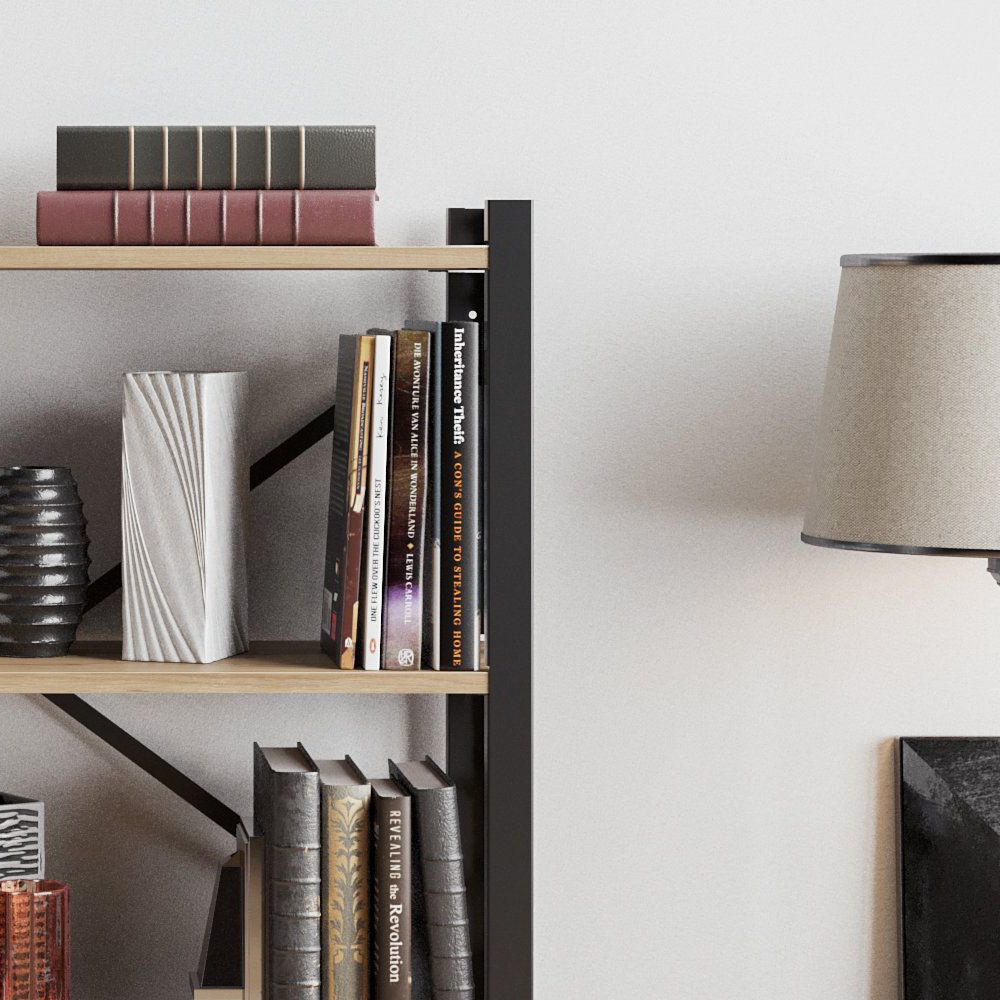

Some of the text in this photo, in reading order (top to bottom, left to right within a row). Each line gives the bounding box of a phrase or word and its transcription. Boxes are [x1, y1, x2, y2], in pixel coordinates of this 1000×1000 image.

[453, 327, 466, 404] Inheritance
[407, 342, 422, 539] DIE AVONTURE VAN ALICE IN WONDERLAND
[373, 500, 381, 541] CUCKOO'S
[374, 478, 382, 499] NEST
[371, 582, 379, 604] FLEW
[372, 559, 380, 581] OVER
[404, 553, 414, 625] LEWIS CARROLL
[452, 451, 463, 667] A CON'S GUIDE TO STEALING HOME
[389, 810, 403, 983] REVEALING the Revolution
